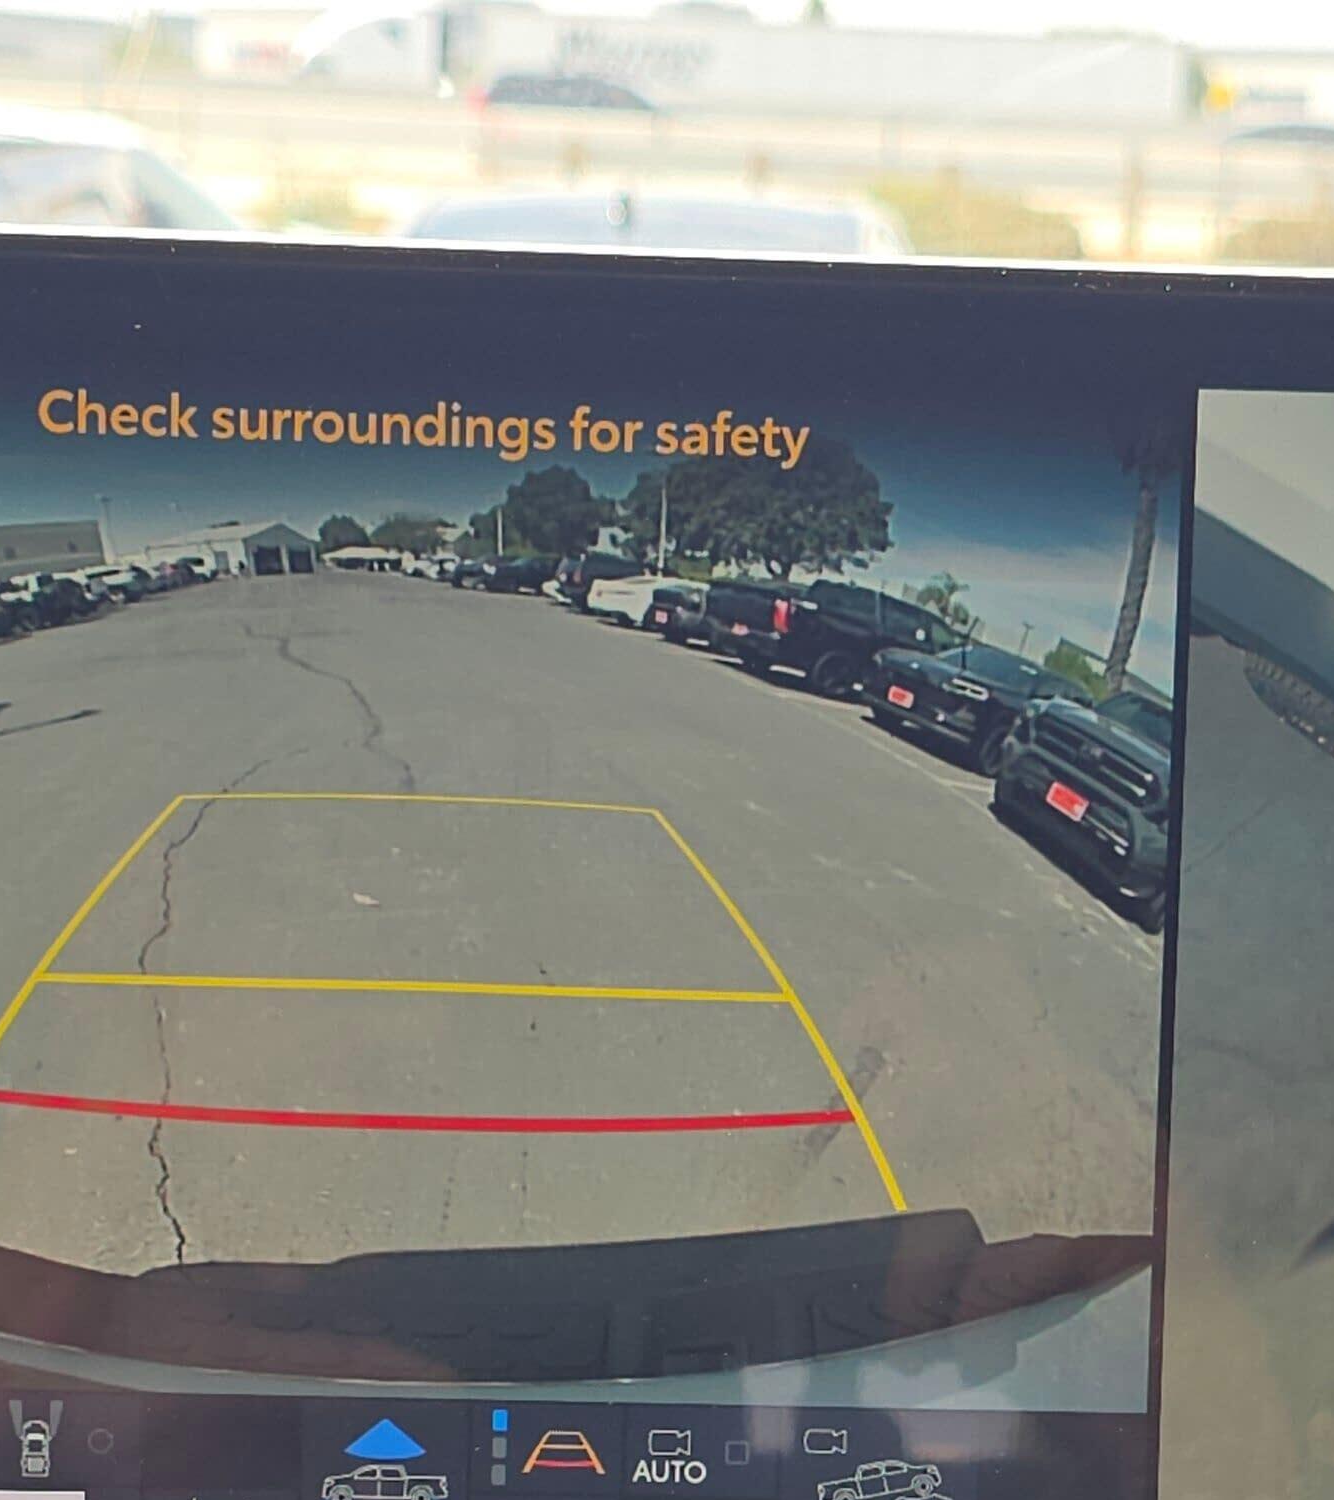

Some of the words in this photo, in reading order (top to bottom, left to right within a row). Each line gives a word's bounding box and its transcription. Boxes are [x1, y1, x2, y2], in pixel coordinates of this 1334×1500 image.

[38, 389, 197, 438] Check
[211, 401, 556, 462] surroundings
[570, 406, 642, 453] for
[656, 410, 809, 468] safety
[632, 1459, 707, 1484] AUTO
